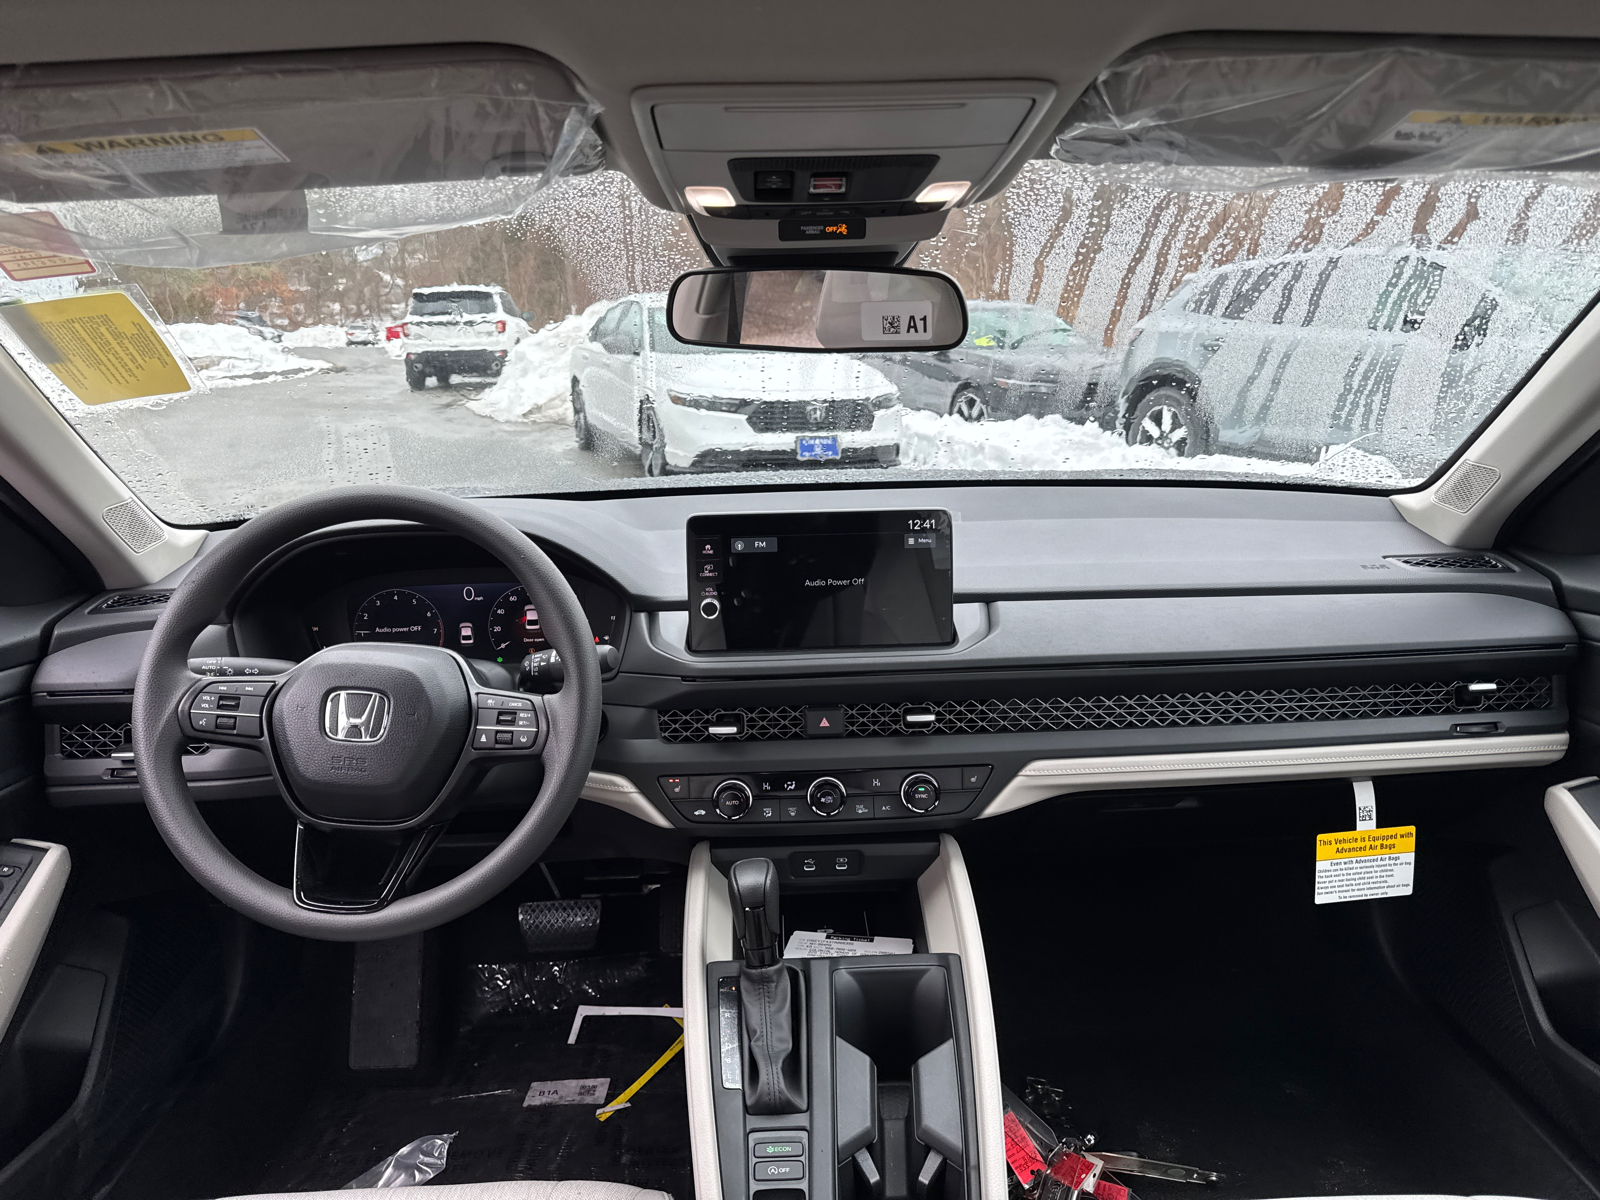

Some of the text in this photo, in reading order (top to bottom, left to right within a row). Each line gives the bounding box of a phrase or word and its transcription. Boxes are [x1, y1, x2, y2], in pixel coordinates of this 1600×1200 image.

[74, 133, 226, 152] WARNING
[906, 315, 927, 334] A1
[908, 520, 936, 530] 12:41
[805, 578, 865, 586] Audio Power Off
[464, 586, 474, 601] 0
[1334, 837, 1358, 845] Vehicle
[1368, 833, 1398, 842] Equipped
[1400, 831, 1413, 839] with
[1336, 845, 1367, 854] Advanced
[1355, 857, 1378, 865] Advanced
